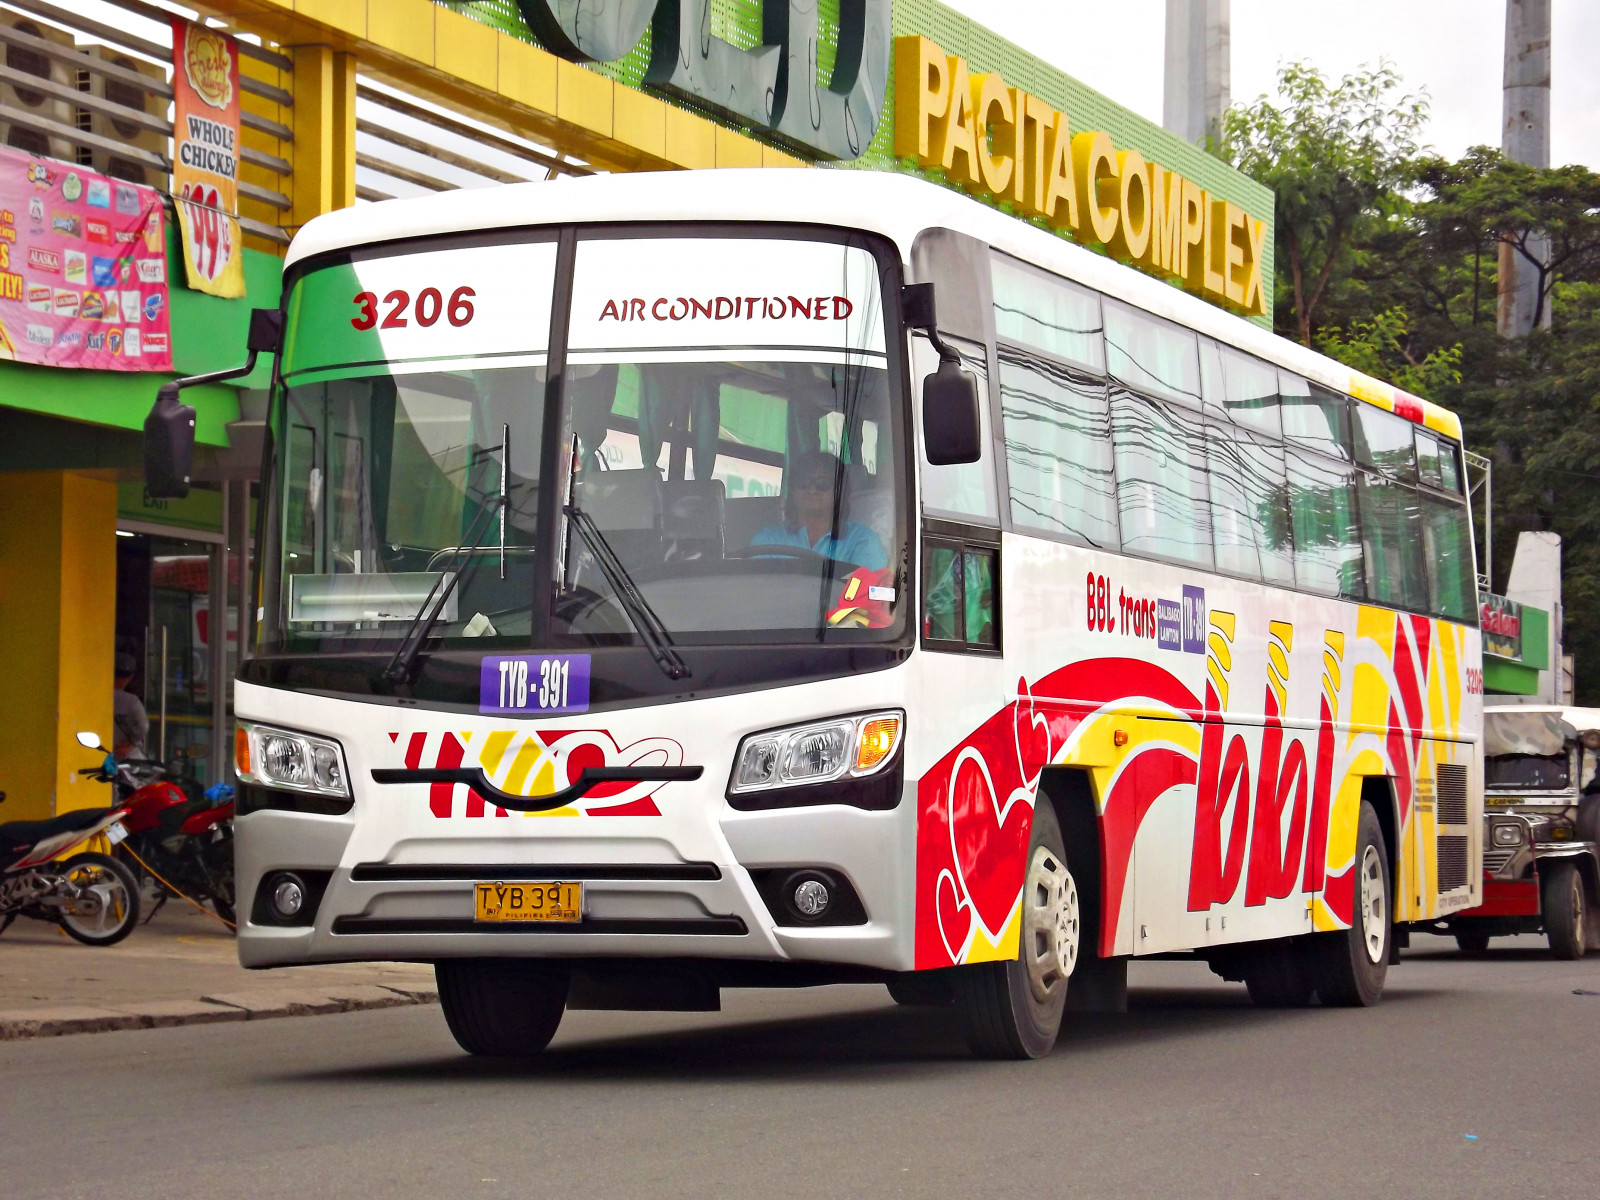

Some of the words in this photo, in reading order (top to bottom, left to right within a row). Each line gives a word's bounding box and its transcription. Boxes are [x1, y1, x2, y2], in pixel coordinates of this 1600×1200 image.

[188, 116, 234, 151] WHOLE
[180, 143, 237, 181] CHICKEN
[897, 35, 1080, 230] PACITA
[1082, 131, 1269, 316] COMPLEX
[30, 248, 59, 267] ALASKA
[350, 286, 476, 331] 3206
[1086, 571, 1115, 634] BBL
[1119, 585, 1156, 640] trans
